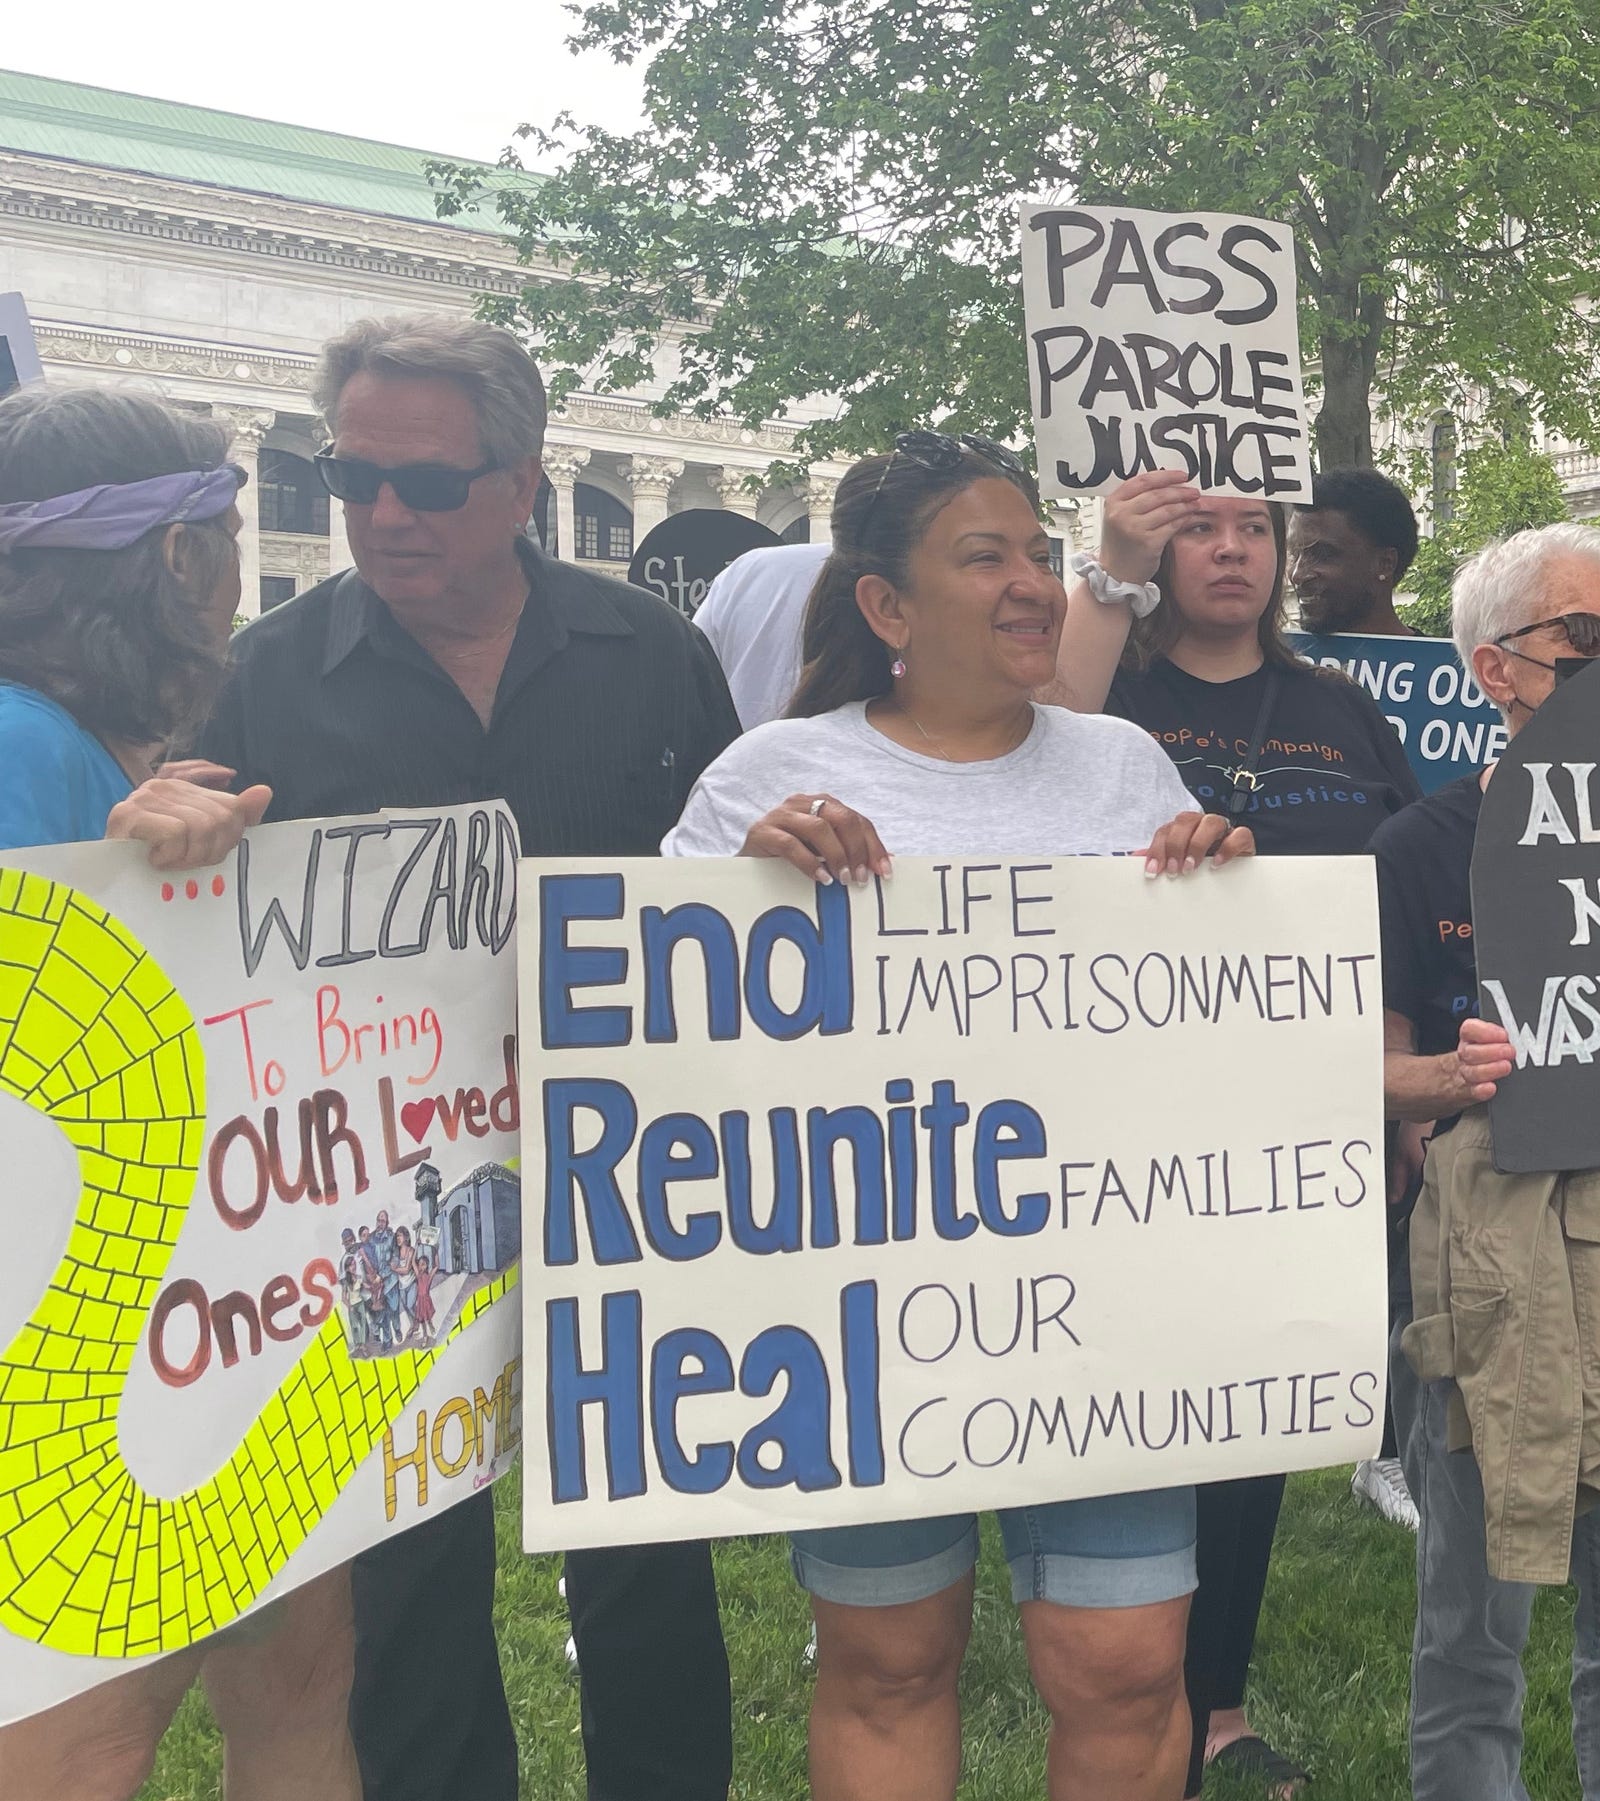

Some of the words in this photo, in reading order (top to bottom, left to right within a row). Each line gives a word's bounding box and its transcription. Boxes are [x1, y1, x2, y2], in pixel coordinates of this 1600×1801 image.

[1029, 211, 1282, 325] PASS
[1031, 326, 1298, 420] PAROLE
[1056, 413, 1301, 496] JUSTICE
[1420, 719, 1508, 765] ONE
[1427, 664, 1498, 709] OU
[538, 872, 854, 1050] End
[875, 863, 1056, 936] LIFE
[876, 952, 1375, 1037] IMPRISONMENT
[204, 999, 286, 1100] To
[317, 985, 442, 1084] Bring
[208, 1088, 369, 1231] OUR
[542, 1077, 1051, 1267] Reunite
[1059, 1139, 1372, 1230] FAMILIES
[149, 1256, 337, 1386] Ones
[382, 1355, 521, 1521] HOME
[545, 1279, 885, 1504] Heal
[898, 1274, 1081, 1363] OUR
[898, 1371, 1378, 1480] COMMUNITIES
